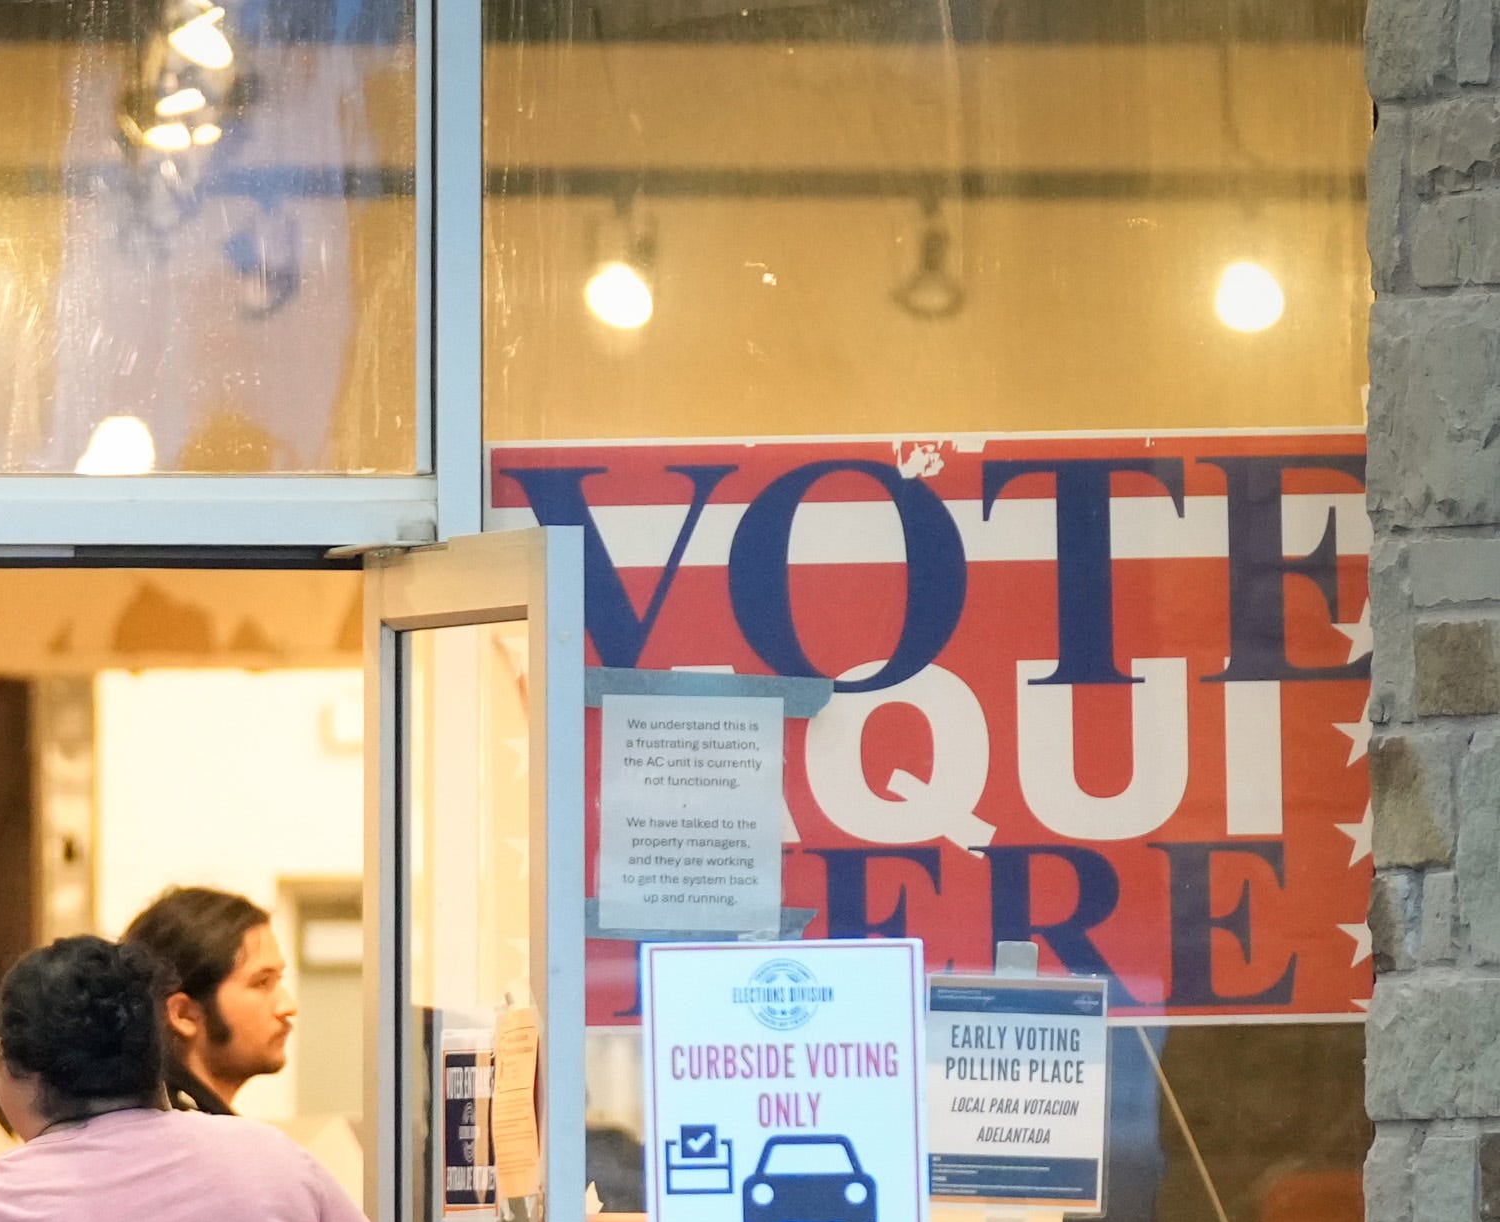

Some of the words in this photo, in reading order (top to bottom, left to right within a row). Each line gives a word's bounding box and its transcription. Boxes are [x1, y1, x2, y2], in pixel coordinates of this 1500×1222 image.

[500, 454, 1370, 693] VOTE
[627, 719, 647, 730] We
[650, 720, 720, 731] understand
[724, 720, 747, 731] this
[750, 720, 759, 731] is
[626, 740, 633, 748] a
[637, 738, 699, 751] frustrating
[702, 739, 759, 751] situation,
[624, 757, 643, 767] the
[647, 758, 664, 767] AC
[668, 758, 690, 768] unit
[694, 758, 703, 768] is
[707, 758, 762, 771] currently
[669, 657, 1282, 857] QUI
[645, 776, 664, 785] not
[668, 776, 740, 788] functioning.
[627, 817, 647, 827] We
[650, 818, 678, 828] have
[681, 818, 718, 829] talked
[722, 819, 734, 829] to
[738, 819, 756, 829] the
[632, 837, 683, 849] property
[687, 838, 750, 849] managers,
[628, 855, 651, 865] and
[655, 855, 681, 867] they
[684, 857, 701, 866] are
[707, 856, 754, 868] working
[623, 874, 634, 883] to
[638, 875, 657, 886] get
[660, 875, 679, 884] the
[683, 875, 726, 887] system
[730, 875, 758, 885] back
[643, 894, 658, 903] up
[661, 893, 684, 903] and
[688, 894, 738, 906] running.
[732, 987, 785, 1003] ELECTIONS
[790, 986, 834, 1002] DIVISION
[951, 1025, 1007, 1050] EARLY
[1015, 1026, 1080, 1052] VOTING
[671, 1043, 796, 1080] CURBSIDE
[805, 1041, 899, 1078] VOTING
[945, 1057, 1020, 1082] POLLING
[1029, 1059, 1084, 1084] PLACE
[758, 1092, 821, 1128] ONLY
[951, 1096, 985, 1114] LOCAL
[989, 1098, 1019, 1114] PARA
[977, 1127, 1051, 1144] ADELANTADA
